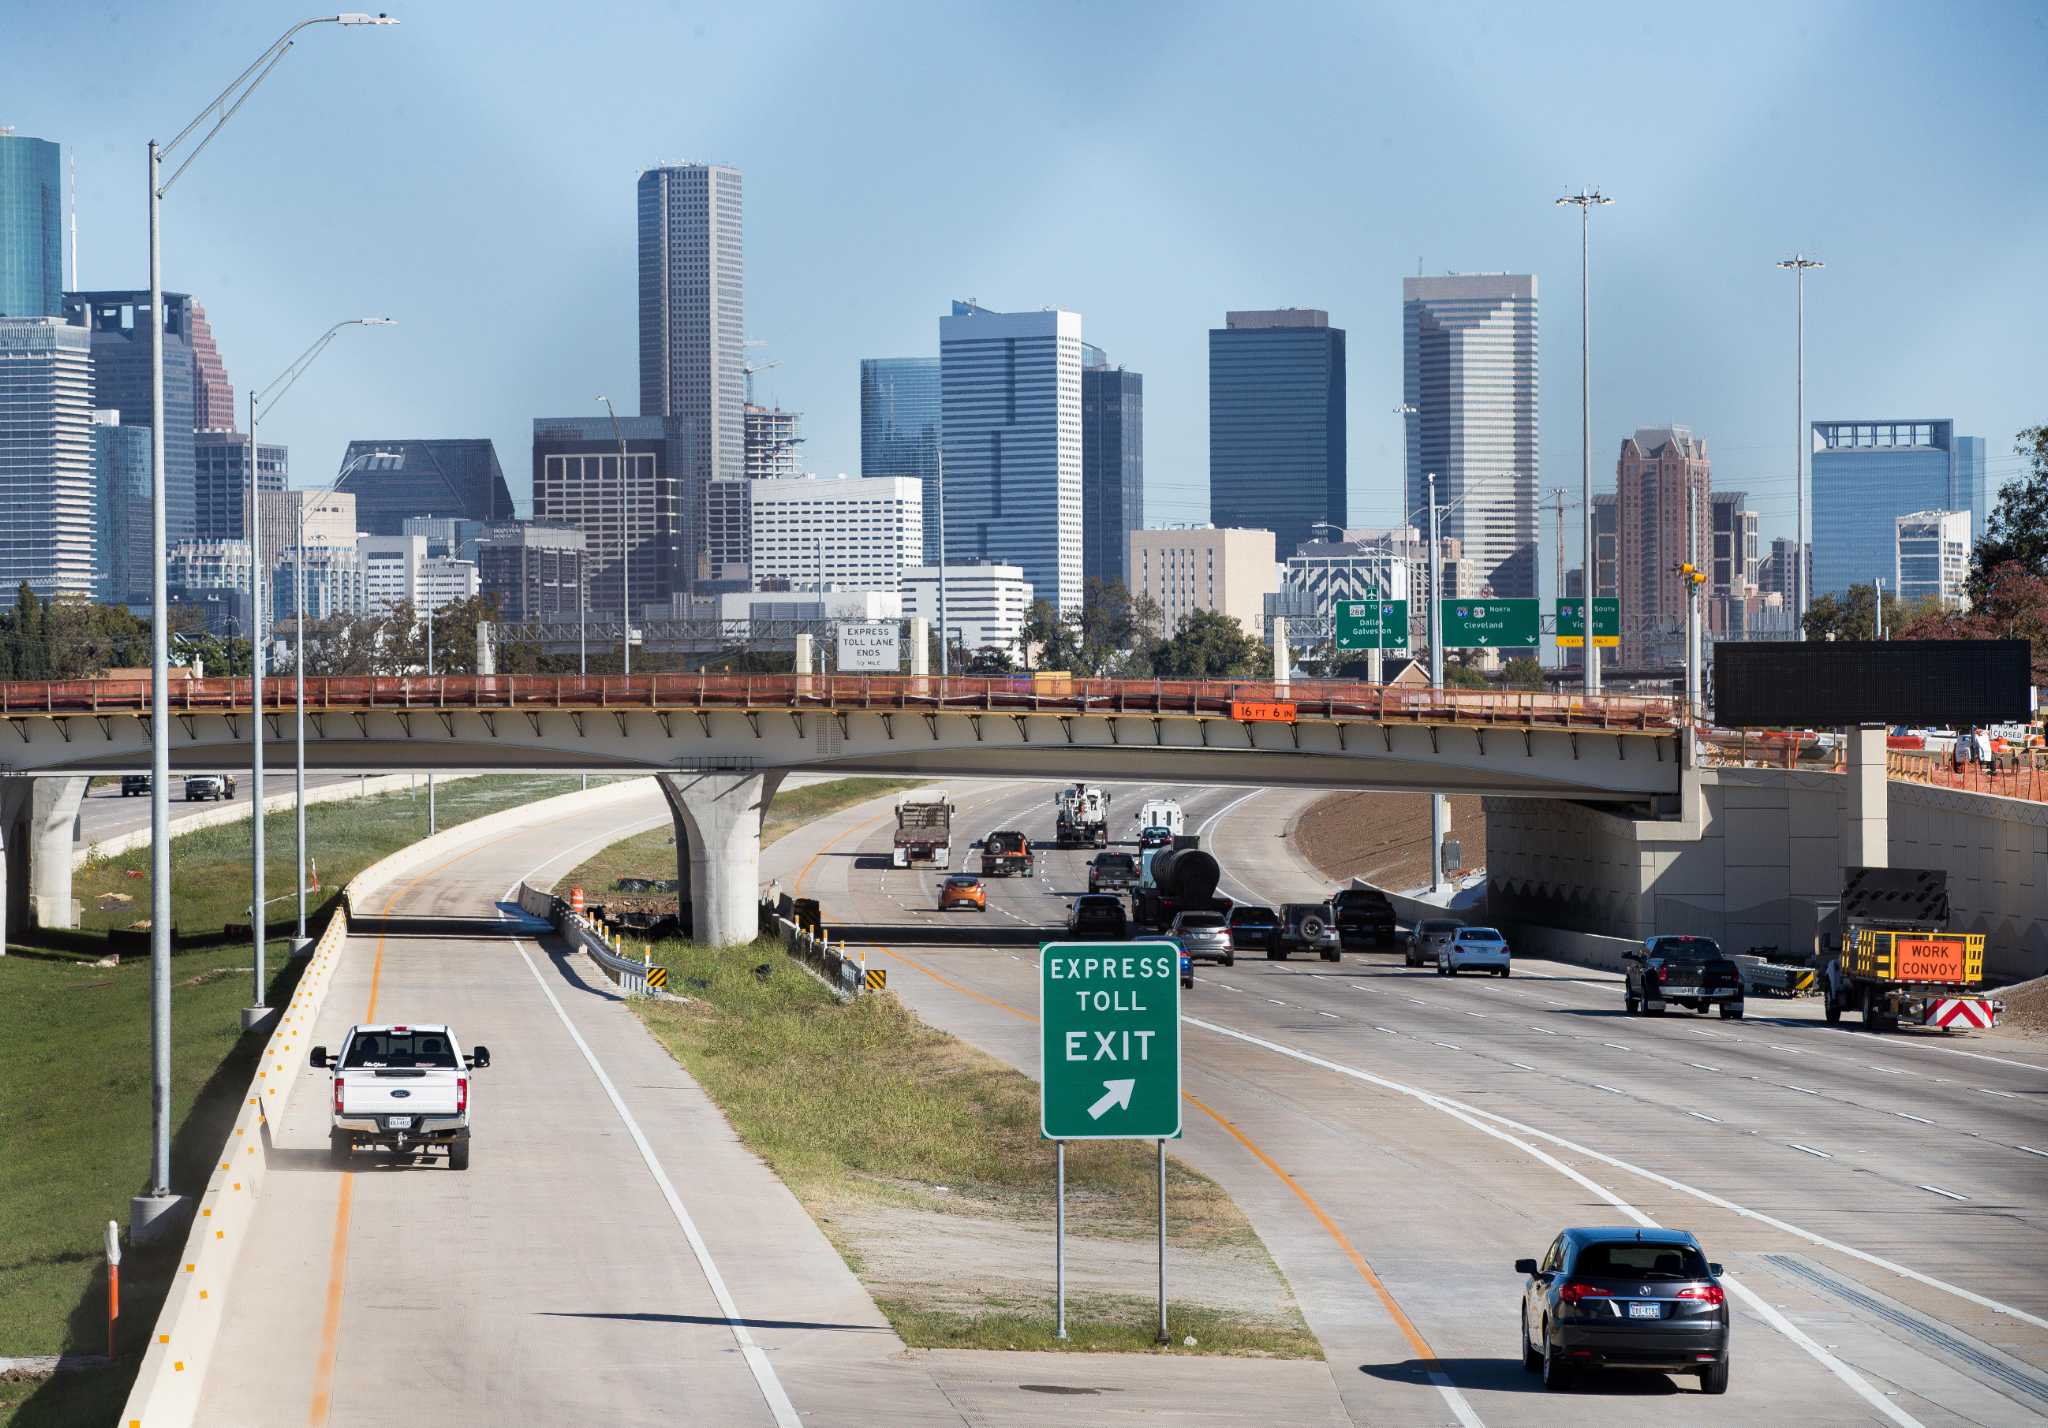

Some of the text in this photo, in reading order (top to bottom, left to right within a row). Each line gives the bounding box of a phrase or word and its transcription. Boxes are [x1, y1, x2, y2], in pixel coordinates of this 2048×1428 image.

[1464, 621, 1503, 629] Cleveland
[847, 628, 889, 636] EXPRESS
[843, 638, 895, 646] TOLL LANE
[1241, 706, 1293, 718] 16 FT 6 IN
[1993, 730, 2022, 739] CLOSED
[1911, 945, 1949, 958] WORK
[1050, 957, 1170, 979] EXPRESS
[1902, 962, 1958, 976] CONVOY
[1076, 990, 1147, 1011] TOLL
[1065, 1031, 1156, 1062] EXIT
